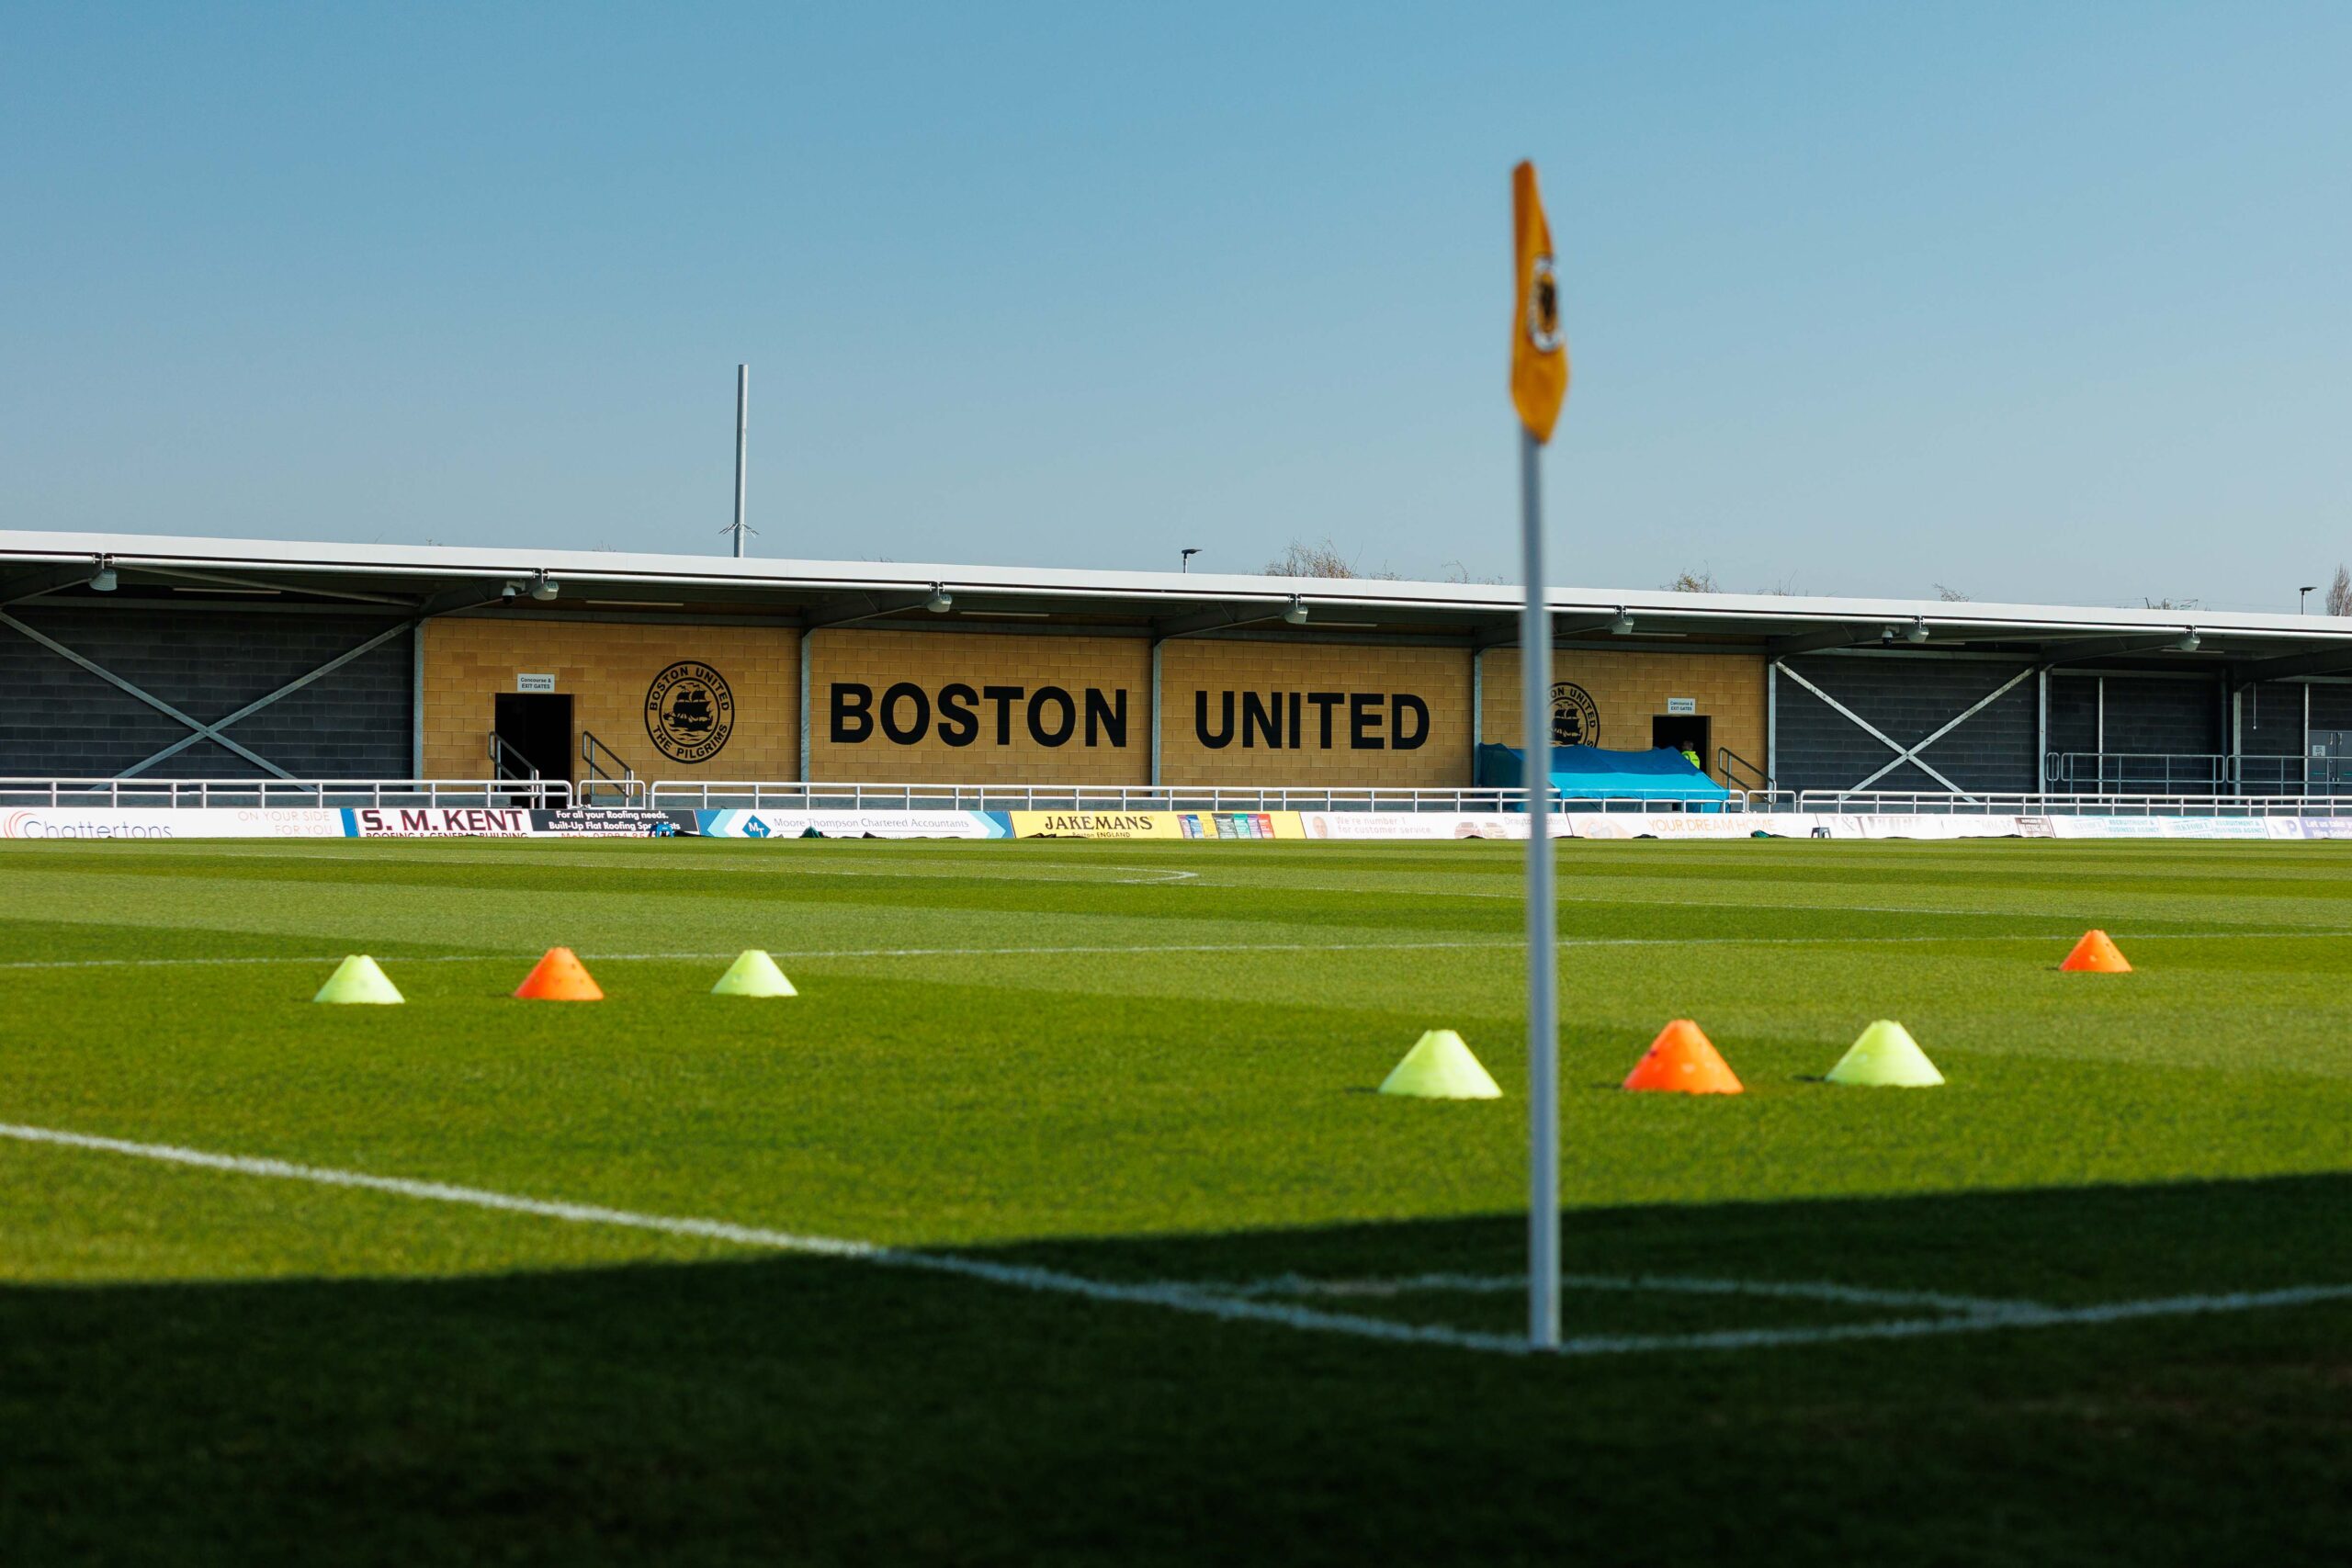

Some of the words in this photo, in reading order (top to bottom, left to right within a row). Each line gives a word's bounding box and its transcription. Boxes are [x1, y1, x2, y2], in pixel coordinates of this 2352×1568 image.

[649, 666, 688, 711] BOSTON
[695, 667, 729, 711] UNITED
[1569, 688, 1596, 728] UNITED
[830, 682, 1127, 748] BOSTON
[1194, 690, 1430, 750] UNITED
[652, 724, 673, 751] THE
[675, 724, 728, 759] PILGRIMS
[237, 810, 258, 821] ON
[264, 810, 300, 821] YOUR
[303, 810, 331, 821] SIDE
[362, 809, 392, 830] S.
[401, 809, 438, 831] M.
[443, 809, 523, 831] KENT
[556, 810, 571, 818] For
[572, 810, 584, 818] all
[585, 812, 605, 820] your
[606, 810, 639, 820] Roofing
[1335, 816, 1362, 824] We're
[1364, 816, 1396, 824] number
[24, 820, 173, 838] Chattertons
[548, 821, 583, 830] Built-Up
[585, 821, 602, 829] Flat
[604, 821, 636, 831] Roofing
[775, 818, 805, 828] Moore
[808, 818, 858, 829] Thompson
[861, 818, 908, 828] Chartered
[910, 818, 969, 829] Accountants
[1045, 816, 1153, 830] JAKEMANS
[1337, 825, 1351, 833] for
[1354, 826, 1396, 834] customer
[1646, 819, 1683, 831] YOUR
[1686, 819, 1734, 831] DREAM
[1737, 818, 1776, 831] HOME
[275, 825, 301, 835] FOR
[304, 825, 333, 835] YOU
